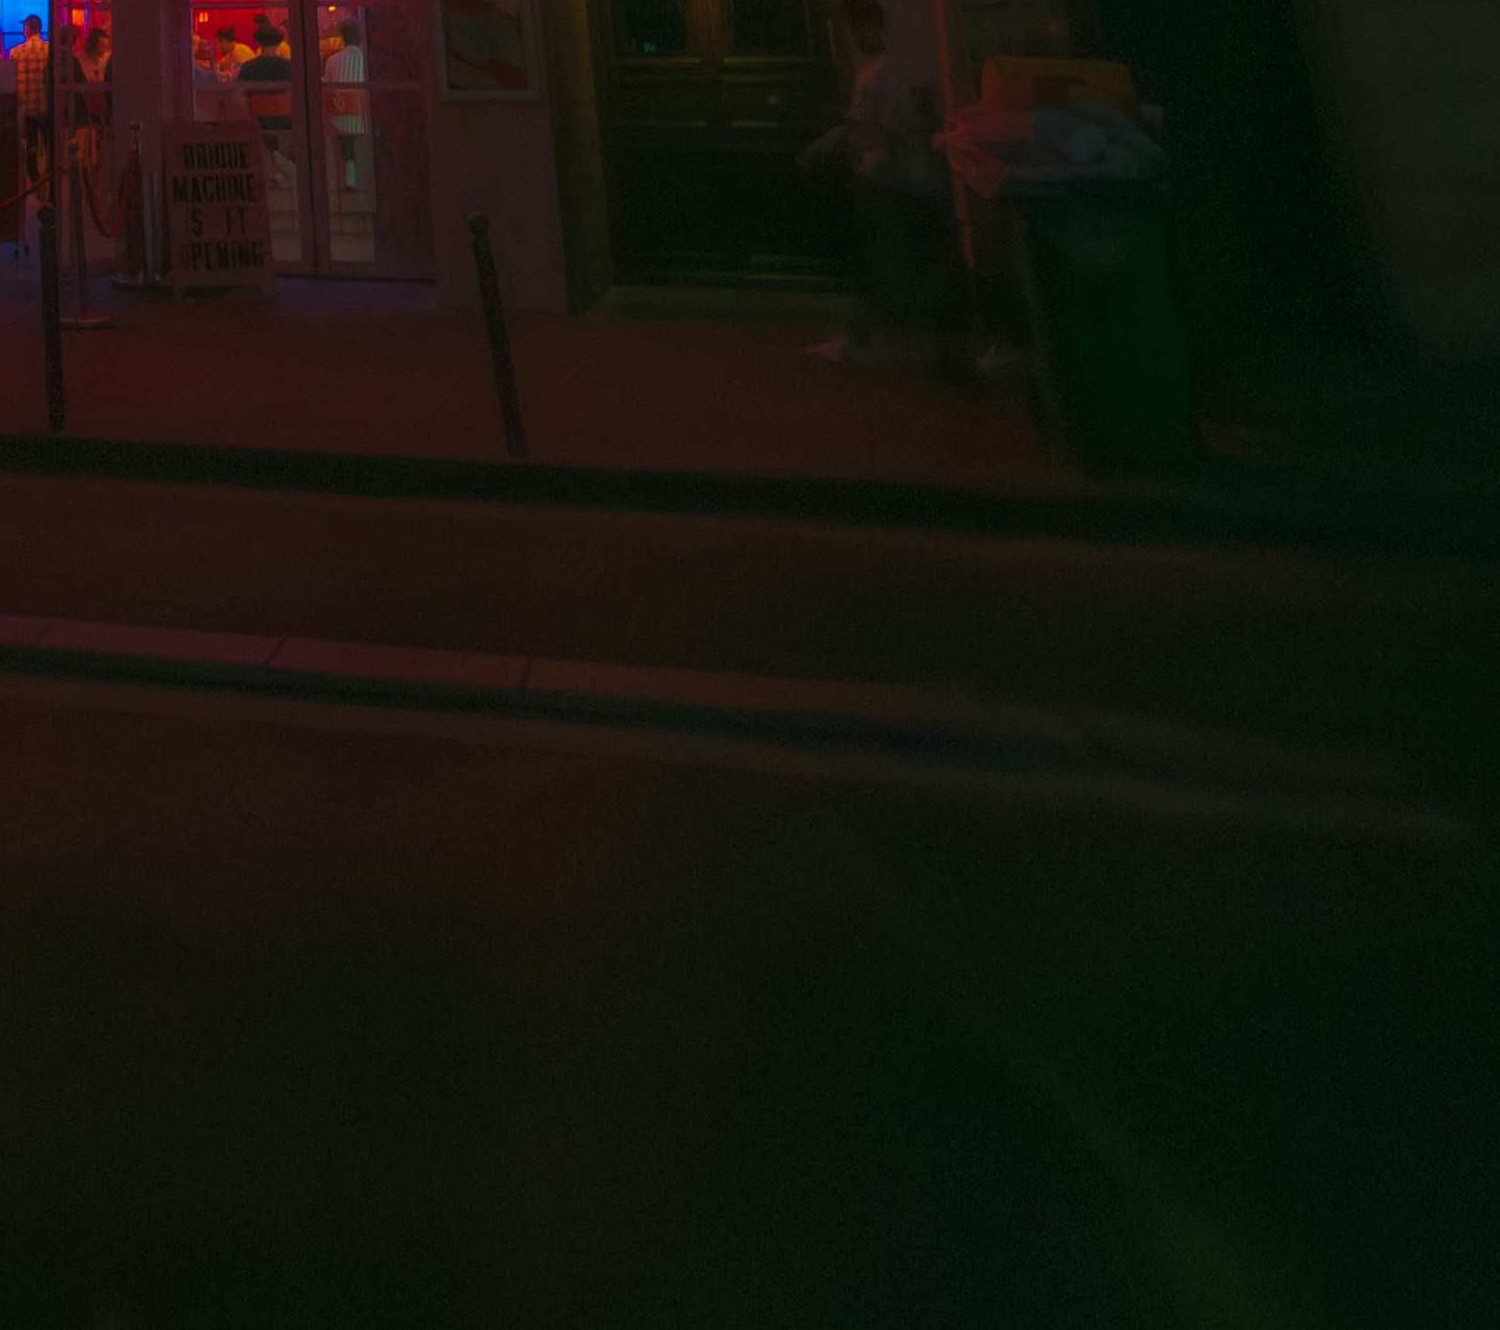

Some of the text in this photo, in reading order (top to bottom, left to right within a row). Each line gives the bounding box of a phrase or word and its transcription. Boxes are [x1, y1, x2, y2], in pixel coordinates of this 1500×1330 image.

[182, 142, 252, 170] BRIQUE
[172, 173, 257, 203] MACHINE
[179, 240, 265, 271] OPENING
